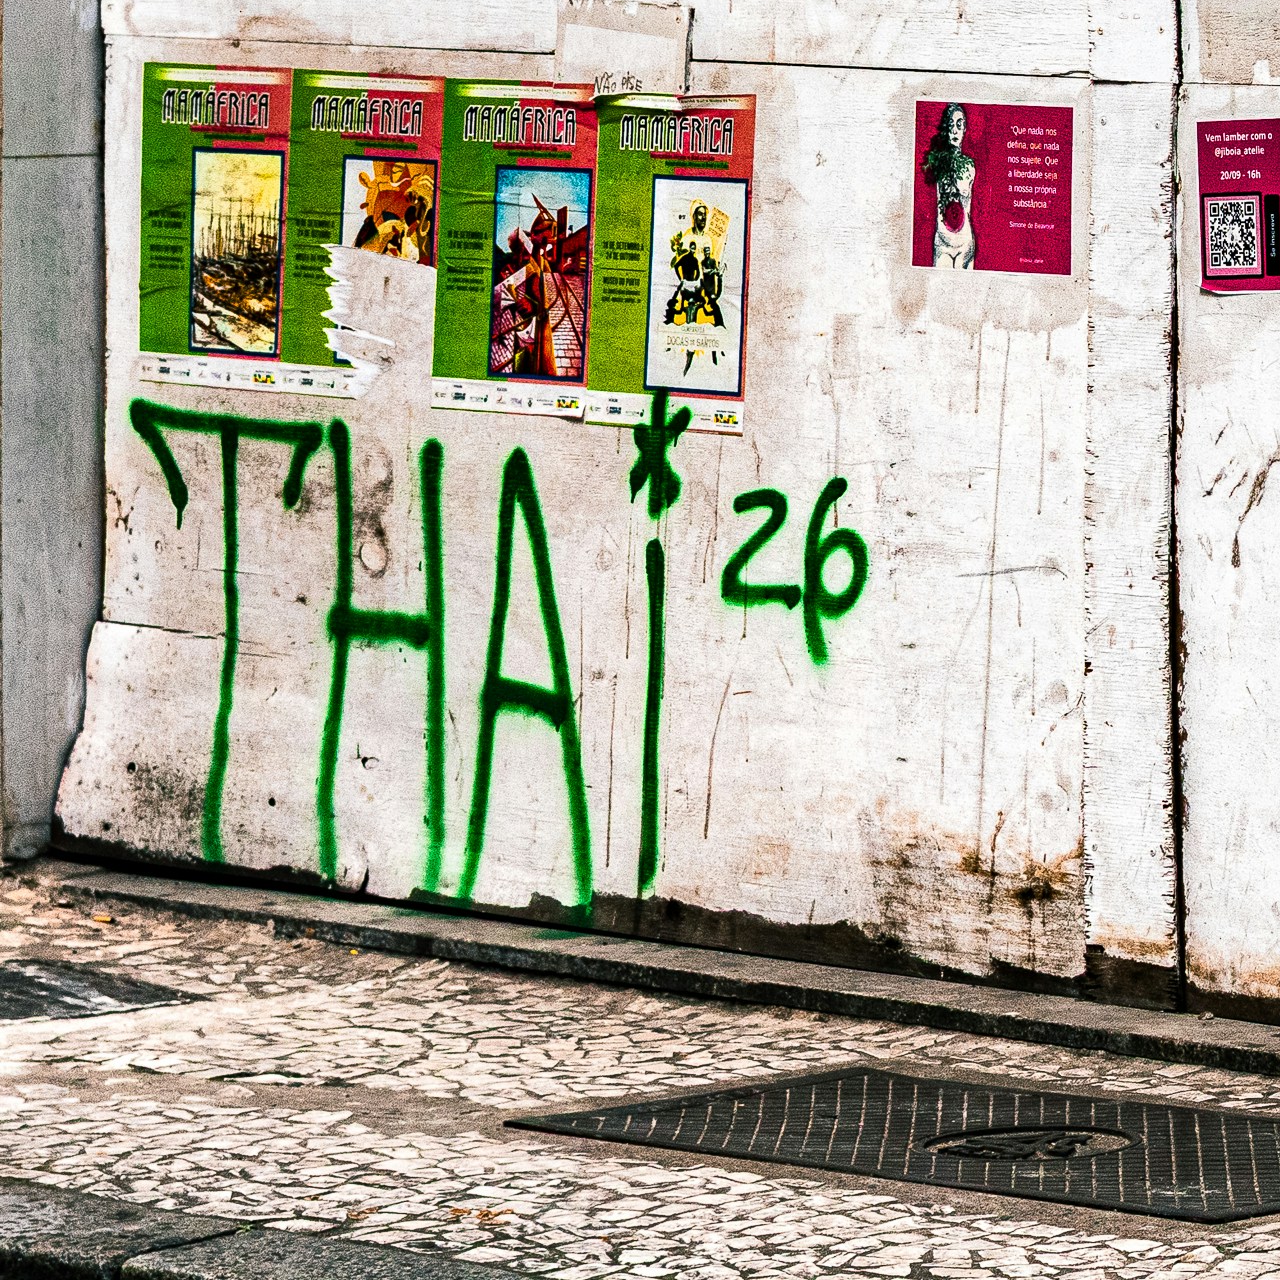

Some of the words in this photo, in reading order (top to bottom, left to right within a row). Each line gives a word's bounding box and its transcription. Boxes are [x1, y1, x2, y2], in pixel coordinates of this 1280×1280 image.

[1028, 126, 1044, 136] nada
[1045, 128, 1057, 136] nos
[1205, 133, 1222, 143] Vem
[1222, 132, 1249, 142] lamber
[1250, 132, 1267, 141] com
[1220, 170, 1242, 181] 20/09
[1247, 170, 1262, 179] 16h
[719, 475, 871, 671] 26
